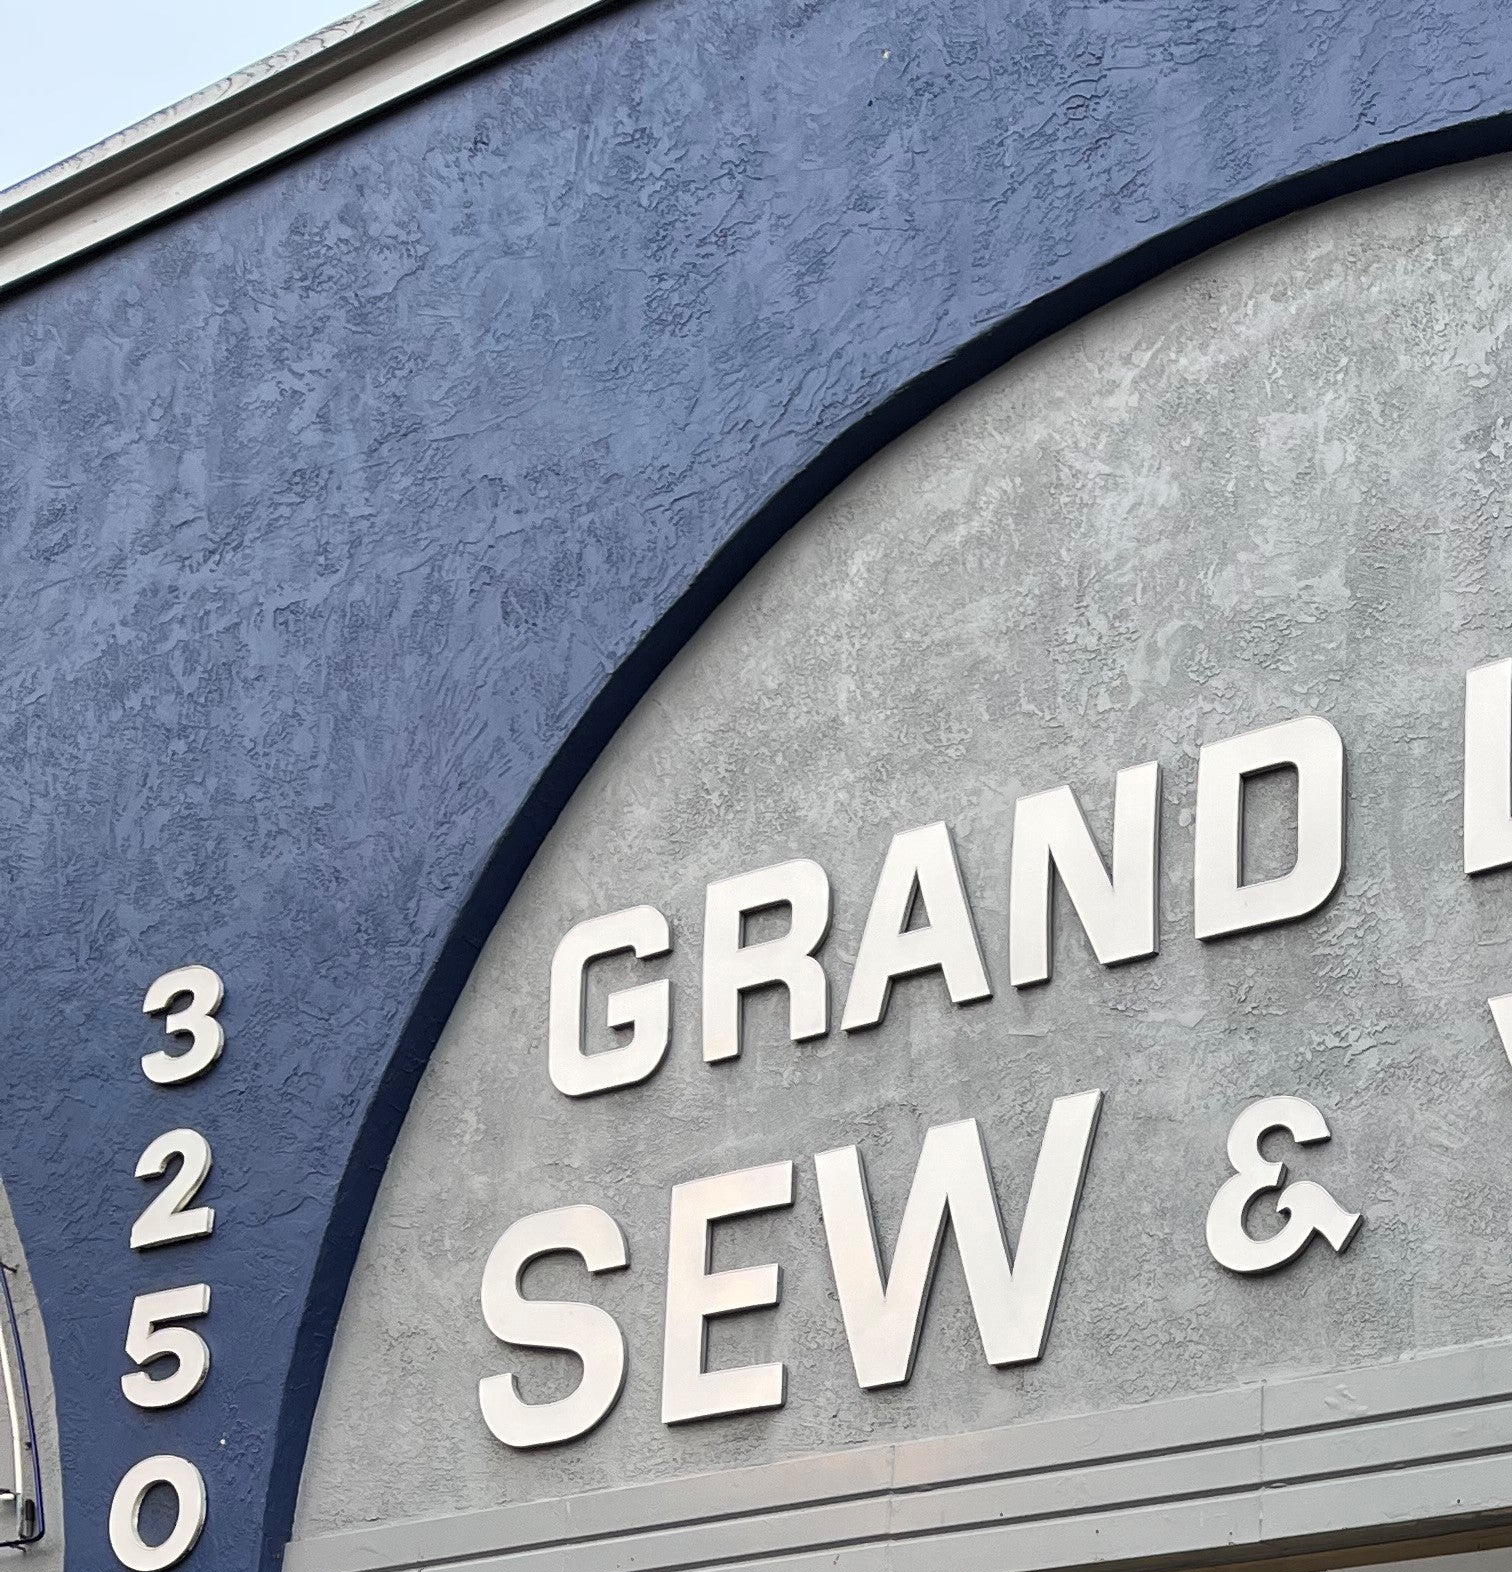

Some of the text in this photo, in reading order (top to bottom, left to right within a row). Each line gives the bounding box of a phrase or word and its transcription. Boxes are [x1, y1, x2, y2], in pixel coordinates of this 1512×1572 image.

[549, 714, 1344, 1097] GRAND
[478, 1088, 1104, 1449] SEW
[1206, 1094, 1364, 1276] &
